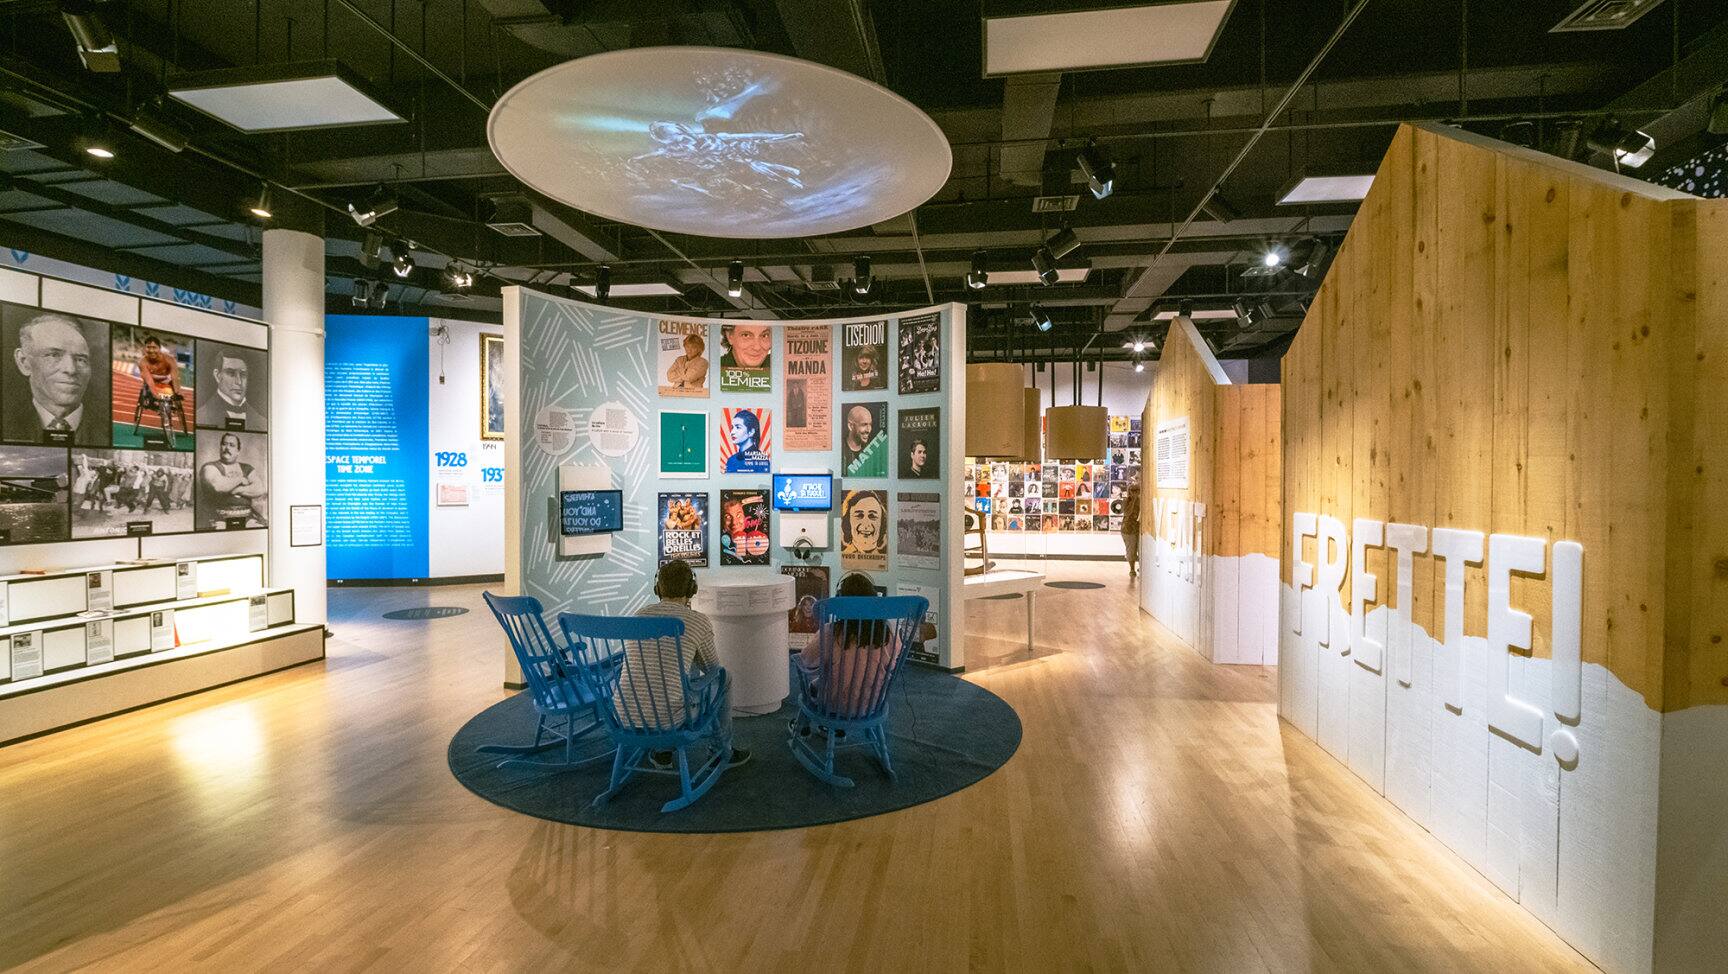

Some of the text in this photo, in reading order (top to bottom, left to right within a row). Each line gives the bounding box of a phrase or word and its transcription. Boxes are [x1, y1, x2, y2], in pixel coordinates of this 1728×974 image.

[786, 340, 829, 355] TIZOUNE
[788, 360, 827, 375] MANDA
[721, 376, 771, 388] LEMIRE
[903, 414, 935, 422] JULIEN
[901, 421, 937, 429] LACROIX
[847, 429, 888, 474] MATTE
[351, 455, 387, 464] TEMPOREL
[434, 451, 468, 468] 1928
[665, 531, 701, 540] ROCK ET
[665, 538, 693, 547] BELLES
[664, 543, 702, 554] OREILLES
[1292, 511, 1583, 771] FRETTE!
